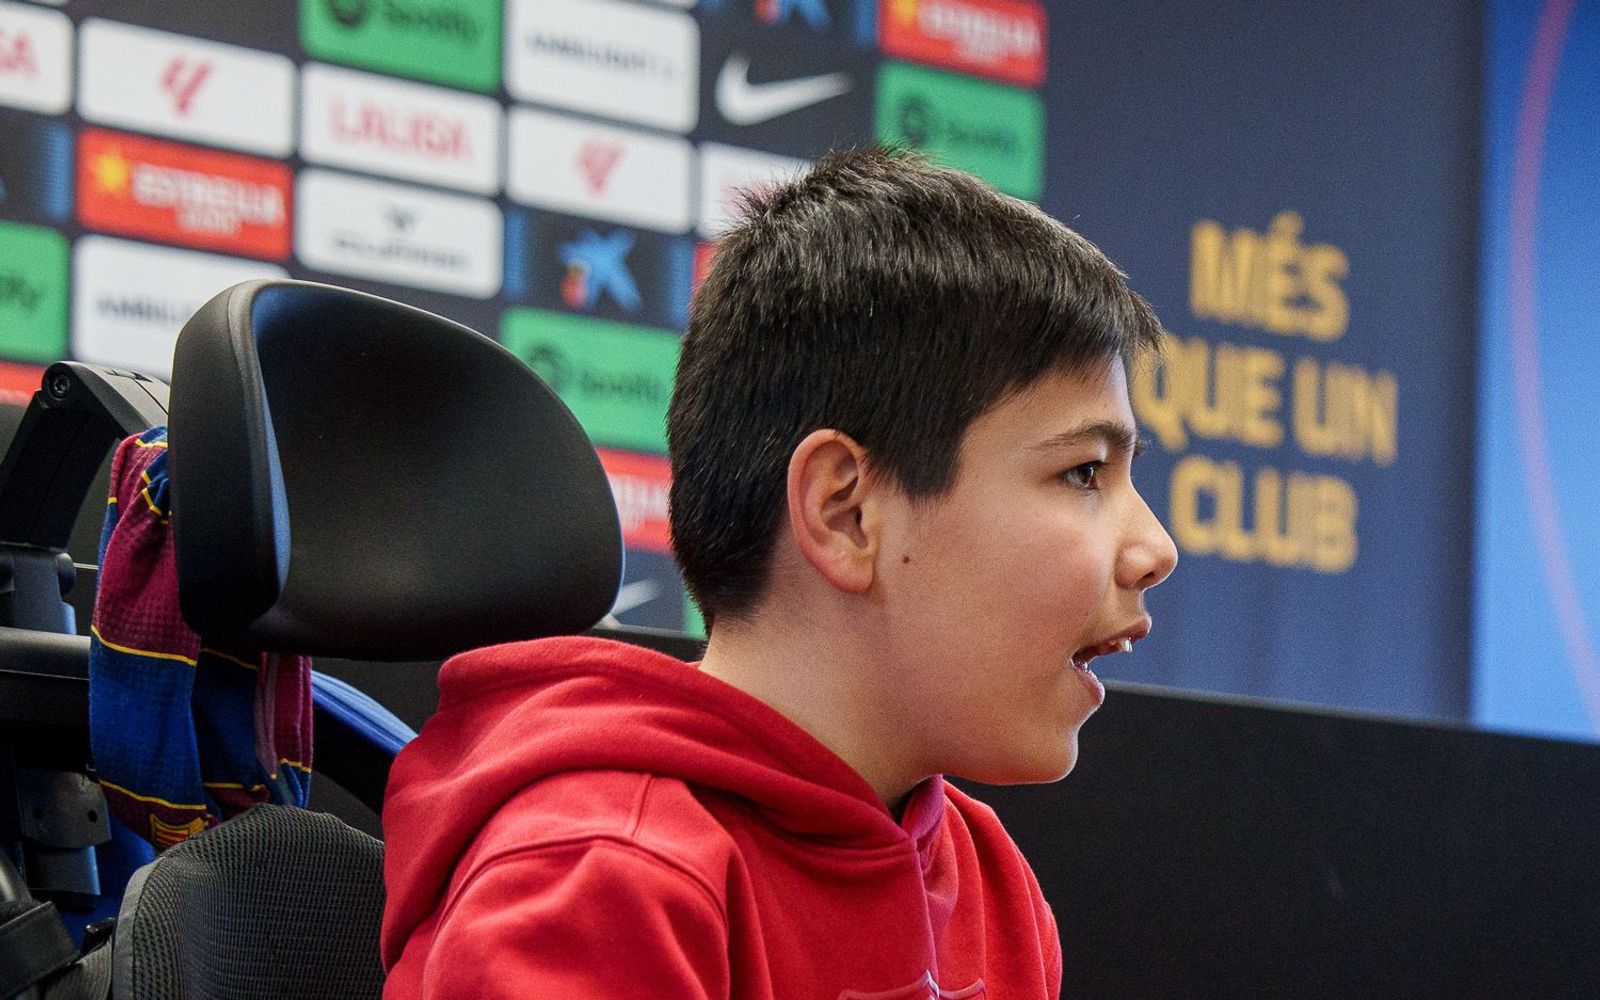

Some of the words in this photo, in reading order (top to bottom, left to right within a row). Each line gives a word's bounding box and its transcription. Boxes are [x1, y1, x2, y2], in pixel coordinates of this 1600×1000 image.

[1190, 209, 1350, 343] MÉS
[1131, 332, 1285, 453] QUE
[1293, 356, 1399, 467] UN
[1170, 454, 1358, 574] CLUB
